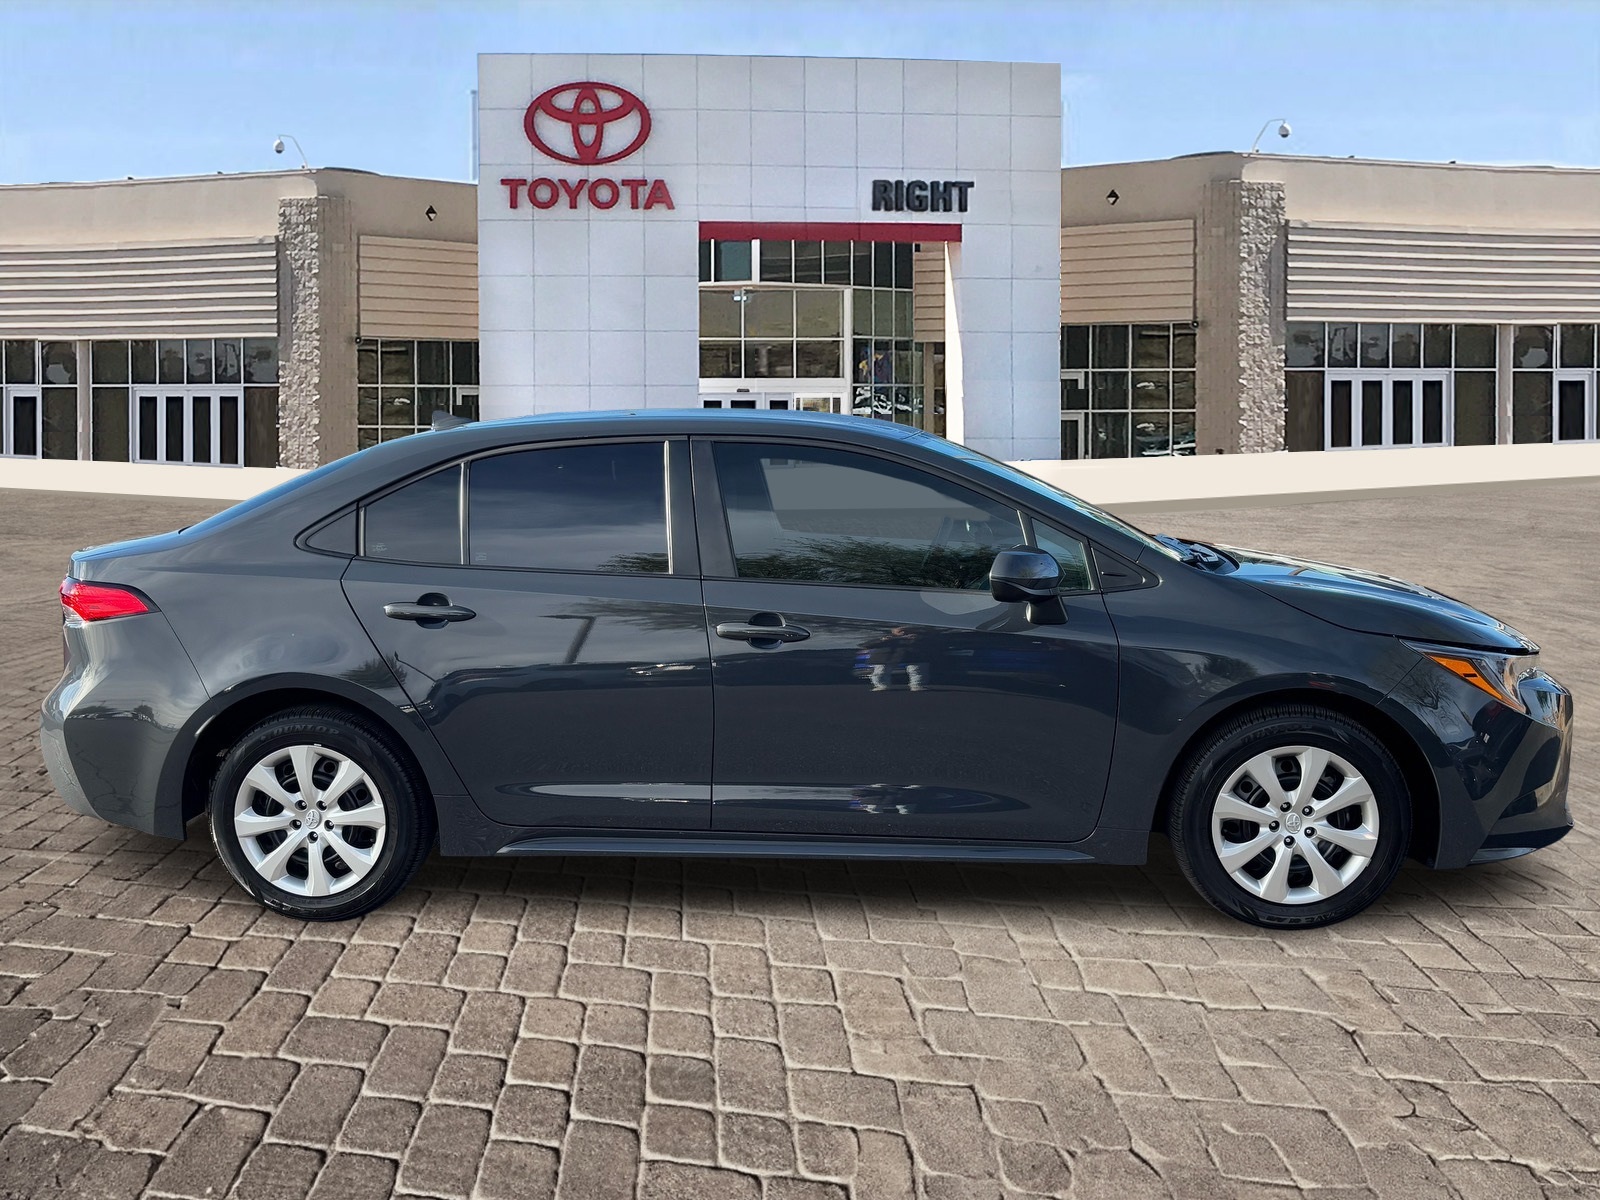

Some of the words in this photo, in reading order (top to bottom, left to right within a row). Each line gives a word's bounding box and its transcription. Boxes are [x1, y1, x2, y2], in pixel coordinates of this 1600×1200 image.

[500, 178, 675, 210] TOYOTA
[872, 179, 975, 212] RIGHT
[273, 724, 340, 735] DUNLOP
